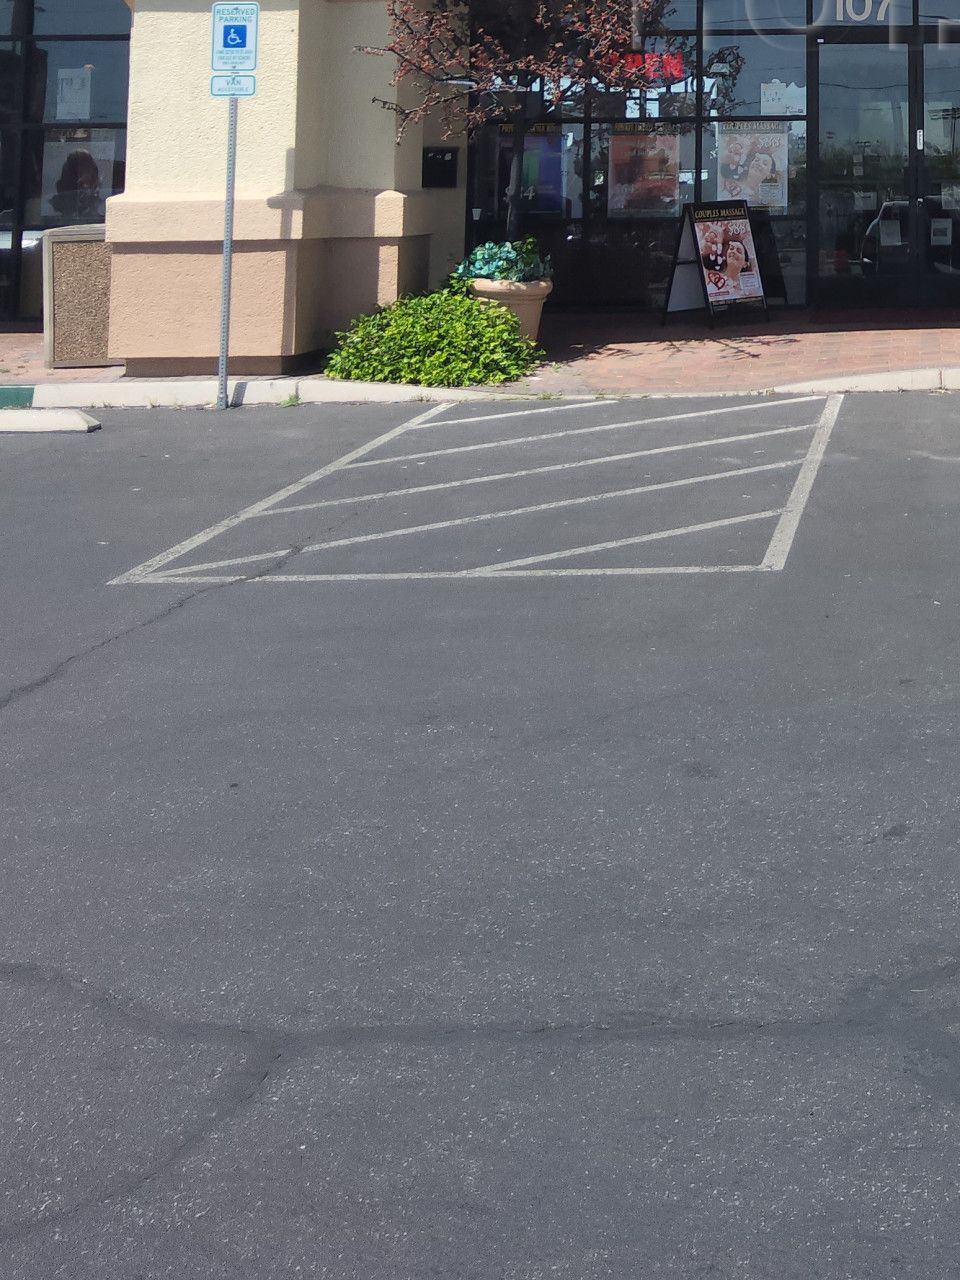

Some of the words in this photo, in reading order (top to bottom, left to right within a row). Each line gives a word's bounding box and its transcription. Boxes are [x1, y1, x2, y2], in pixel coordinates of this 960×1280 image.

[216, 8, 255, 16] RESERVED
[218, 16, 253, 24] PARKING
[226, 79, 242, 87] VAN
[694, 208, 720, 219] COUPLES
[720, 207, 745, 217] MASSAGE
